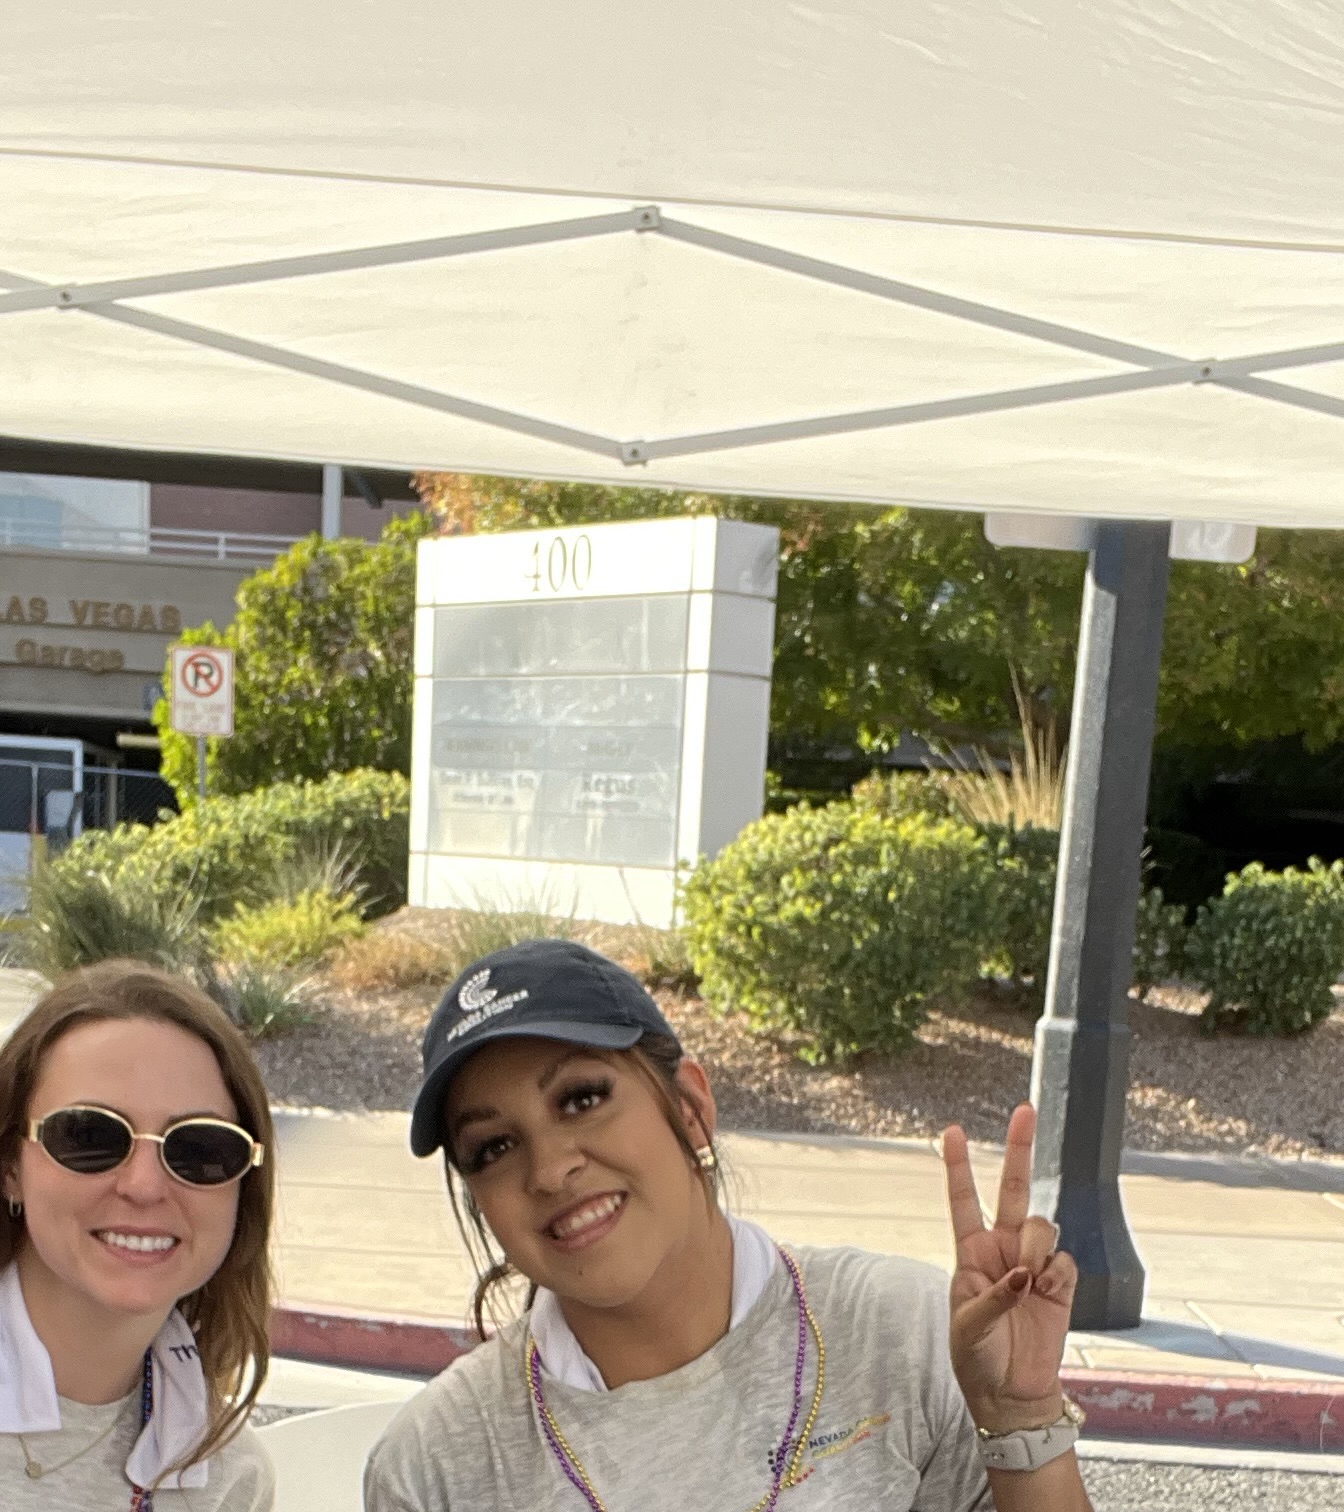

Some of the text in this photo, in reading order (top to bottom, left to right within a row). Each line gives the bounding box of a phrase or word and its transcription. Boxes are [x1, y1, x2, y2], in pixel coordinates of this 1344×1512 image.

[525, 534, 592, 592] 400
[69, 599, 182, 631] VEGAS
[15, 638, 125, 674] Garage
[808, 1427, 854, 1449] NEVADA
